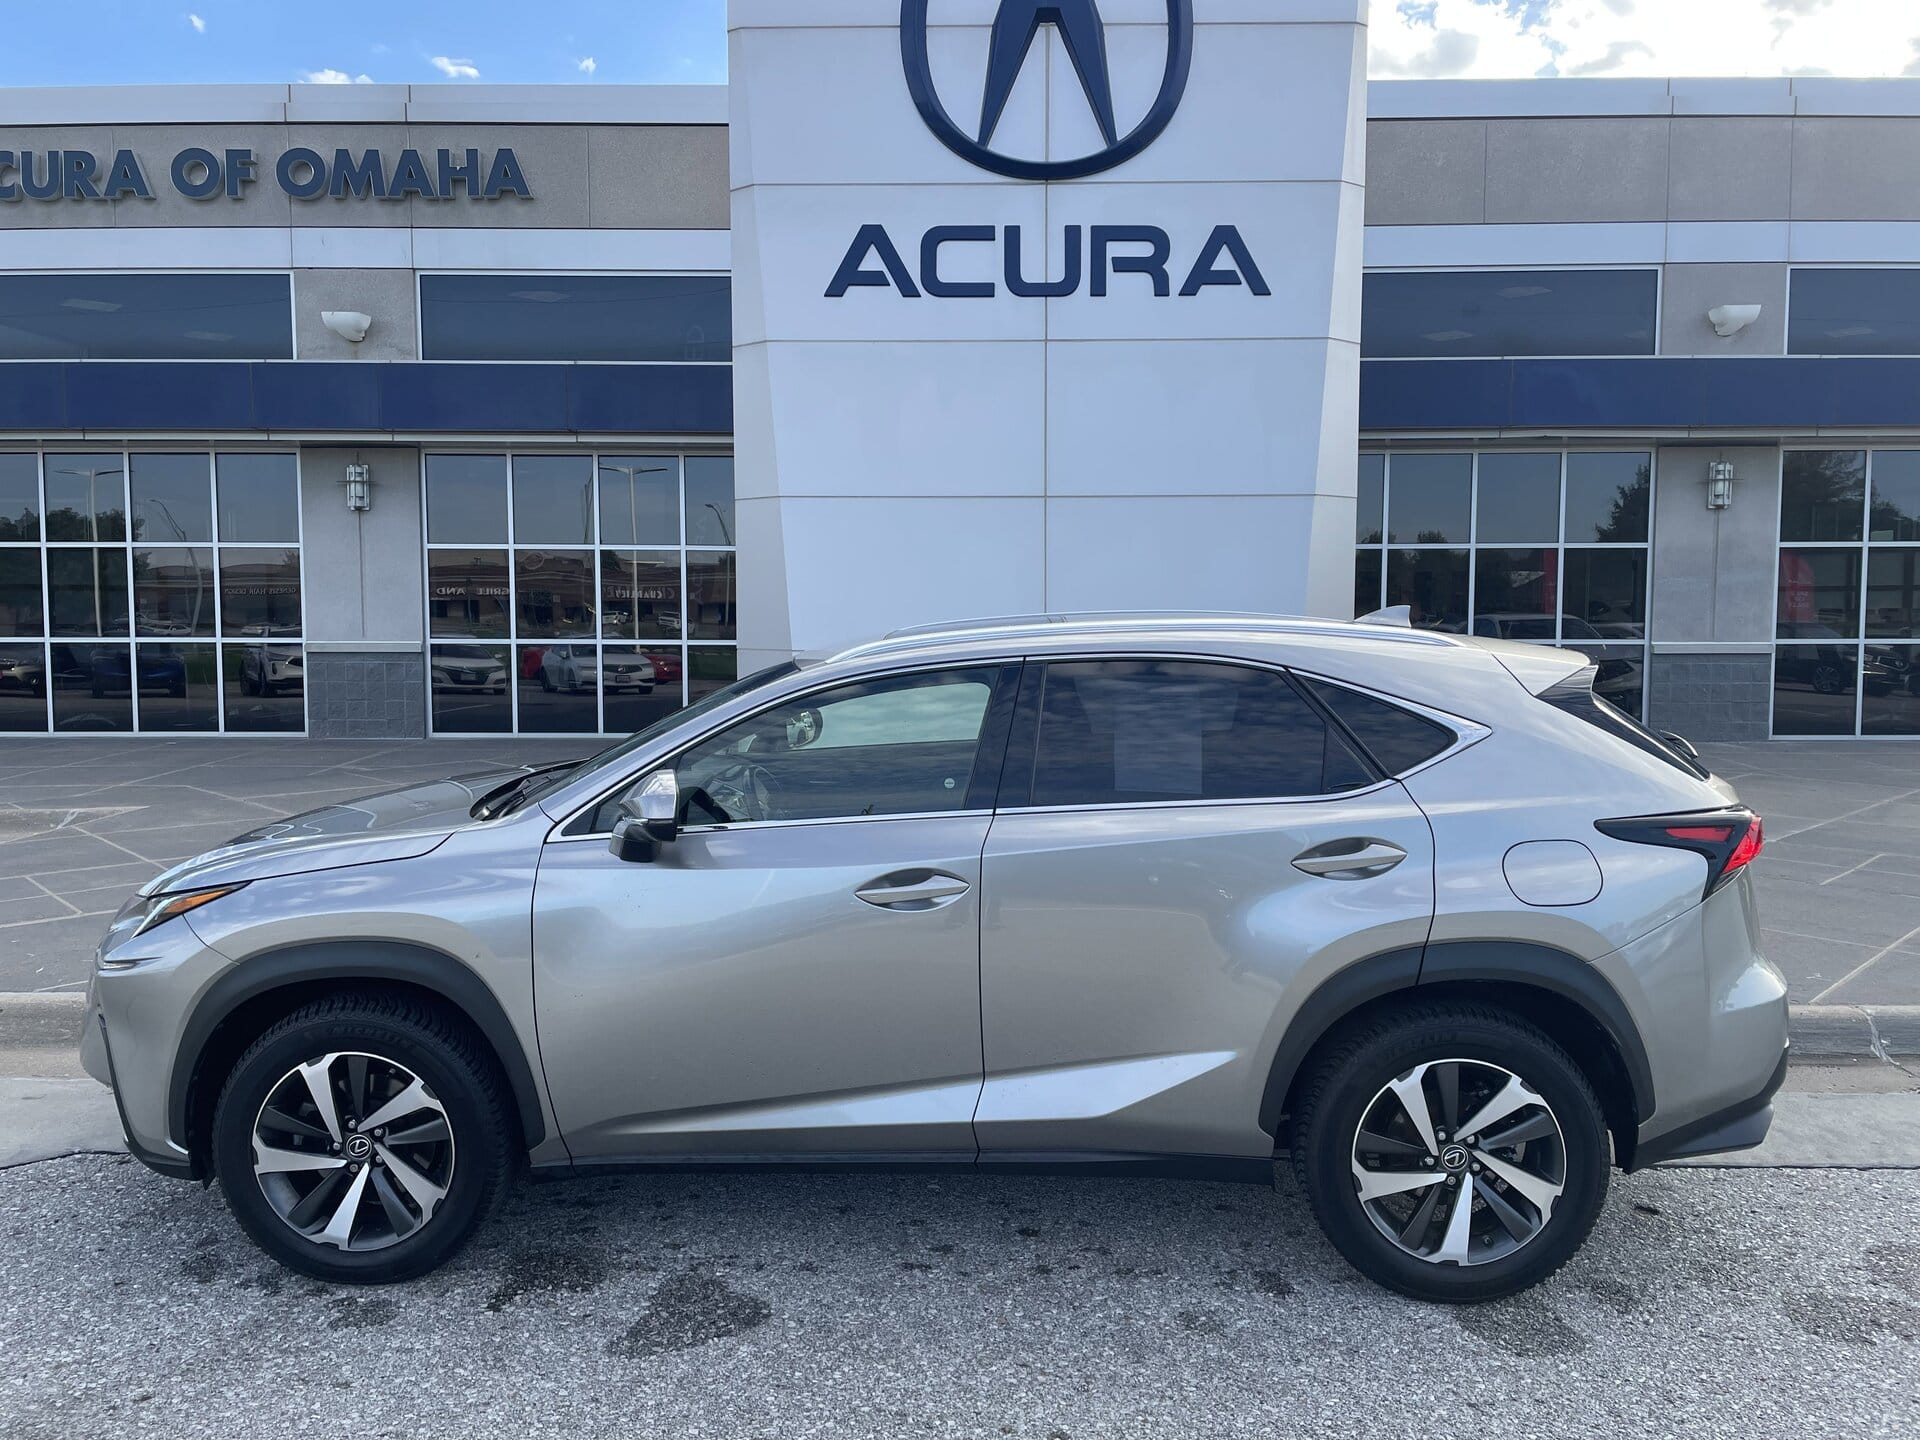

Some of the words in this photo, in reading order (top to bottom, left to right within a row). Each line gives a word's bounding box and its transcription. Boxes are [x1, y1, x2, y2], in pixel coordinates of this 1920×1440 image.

[170, 147, 256, 200] OF
[275, 147, 532, 200] OMAHA
[823, 223, 1272, 298] ACURA
